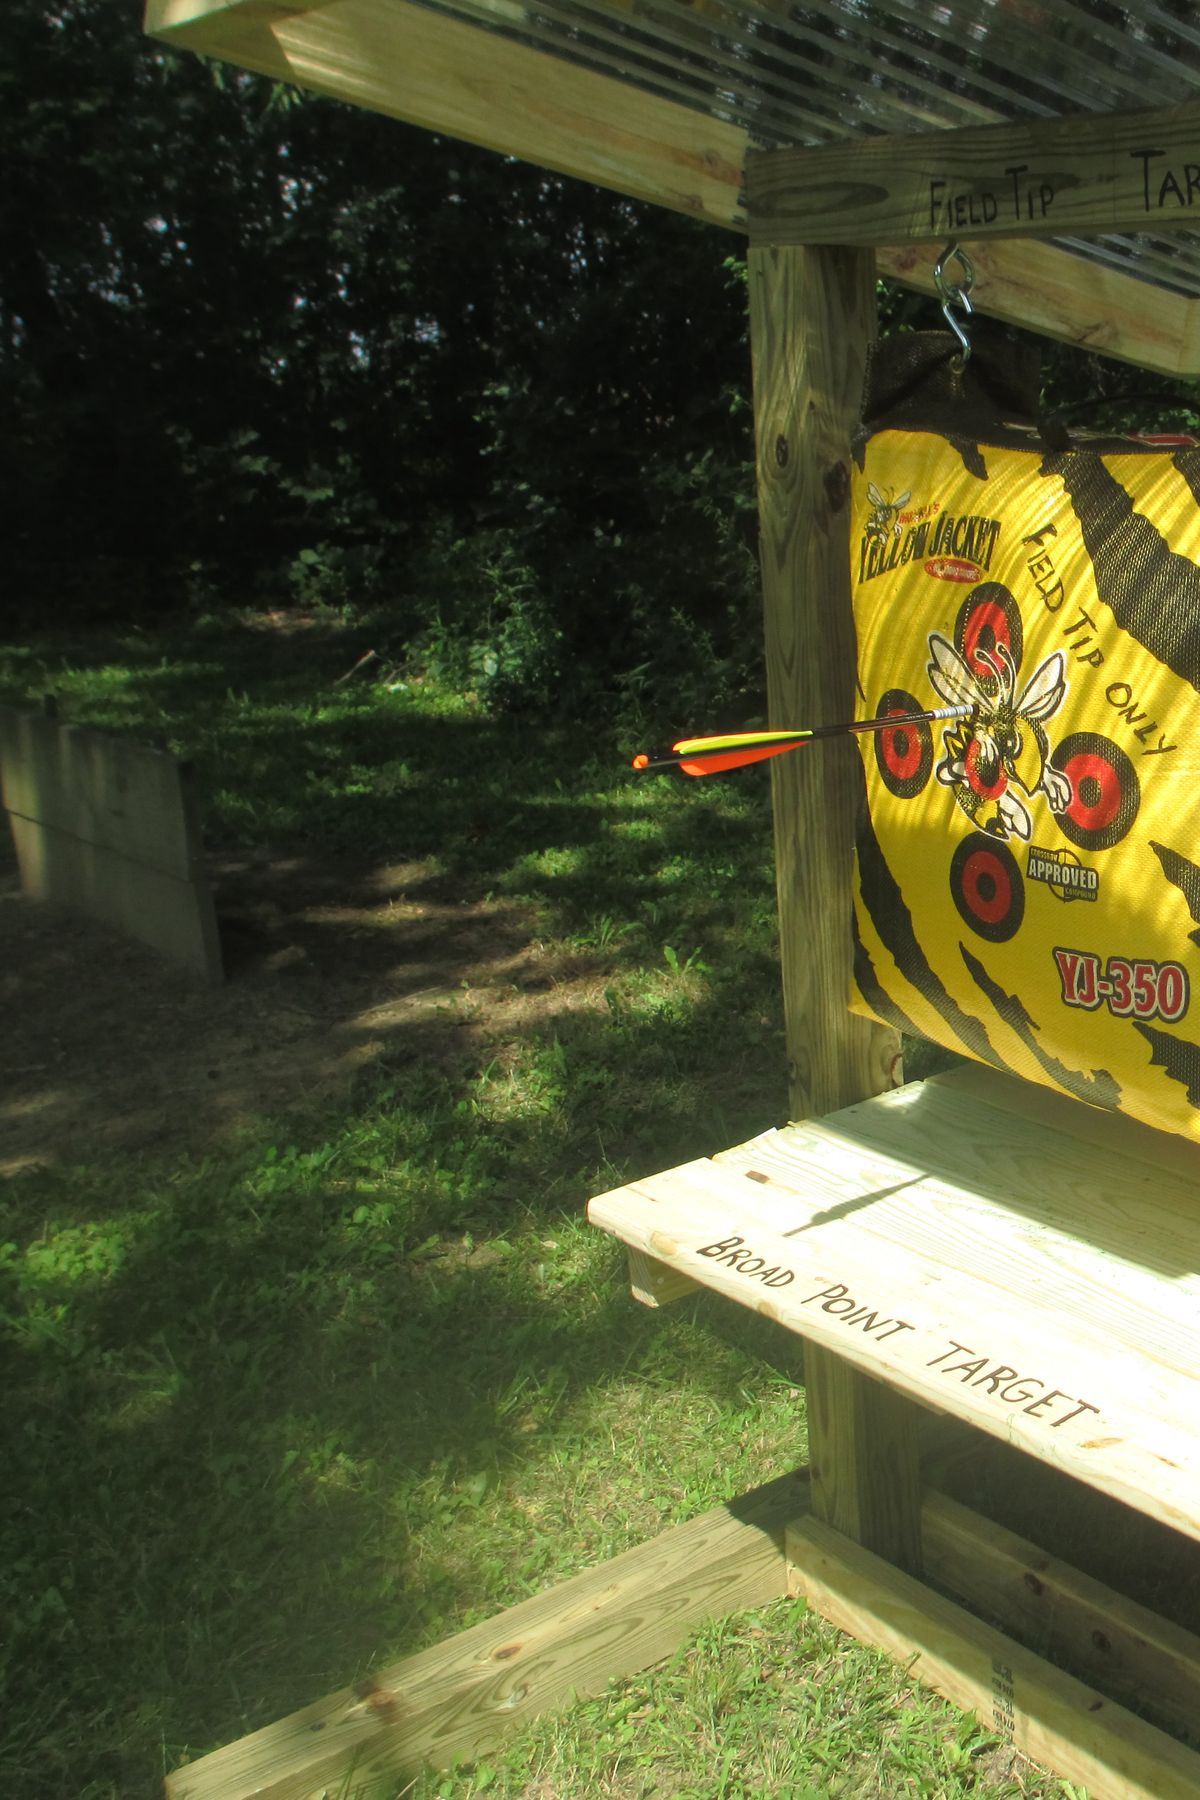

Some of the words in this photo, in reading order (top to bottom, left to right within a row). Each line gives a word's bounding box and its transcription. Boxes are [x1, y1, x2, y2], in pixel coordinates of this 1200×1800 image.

[929, 181, 997, 229] FIELD
[1005, 165, 1055, 221] TIP
[928, 511, 1001, 572] JACKET
[1022, 523, 1065, 612] FIELD
[1063, 606, 1104, 669] TIP
[1105, 682, 1178, 756] ONLY
[1028, 858, 1097, 889] APPROVED
[1053, 948, 1189, 1021] YJ-350
[696, 1236, 795, 1288] BROAD
[801, 1283, 916, 1341] POINT
[926, 1340, 1101, 1427] TARGET
